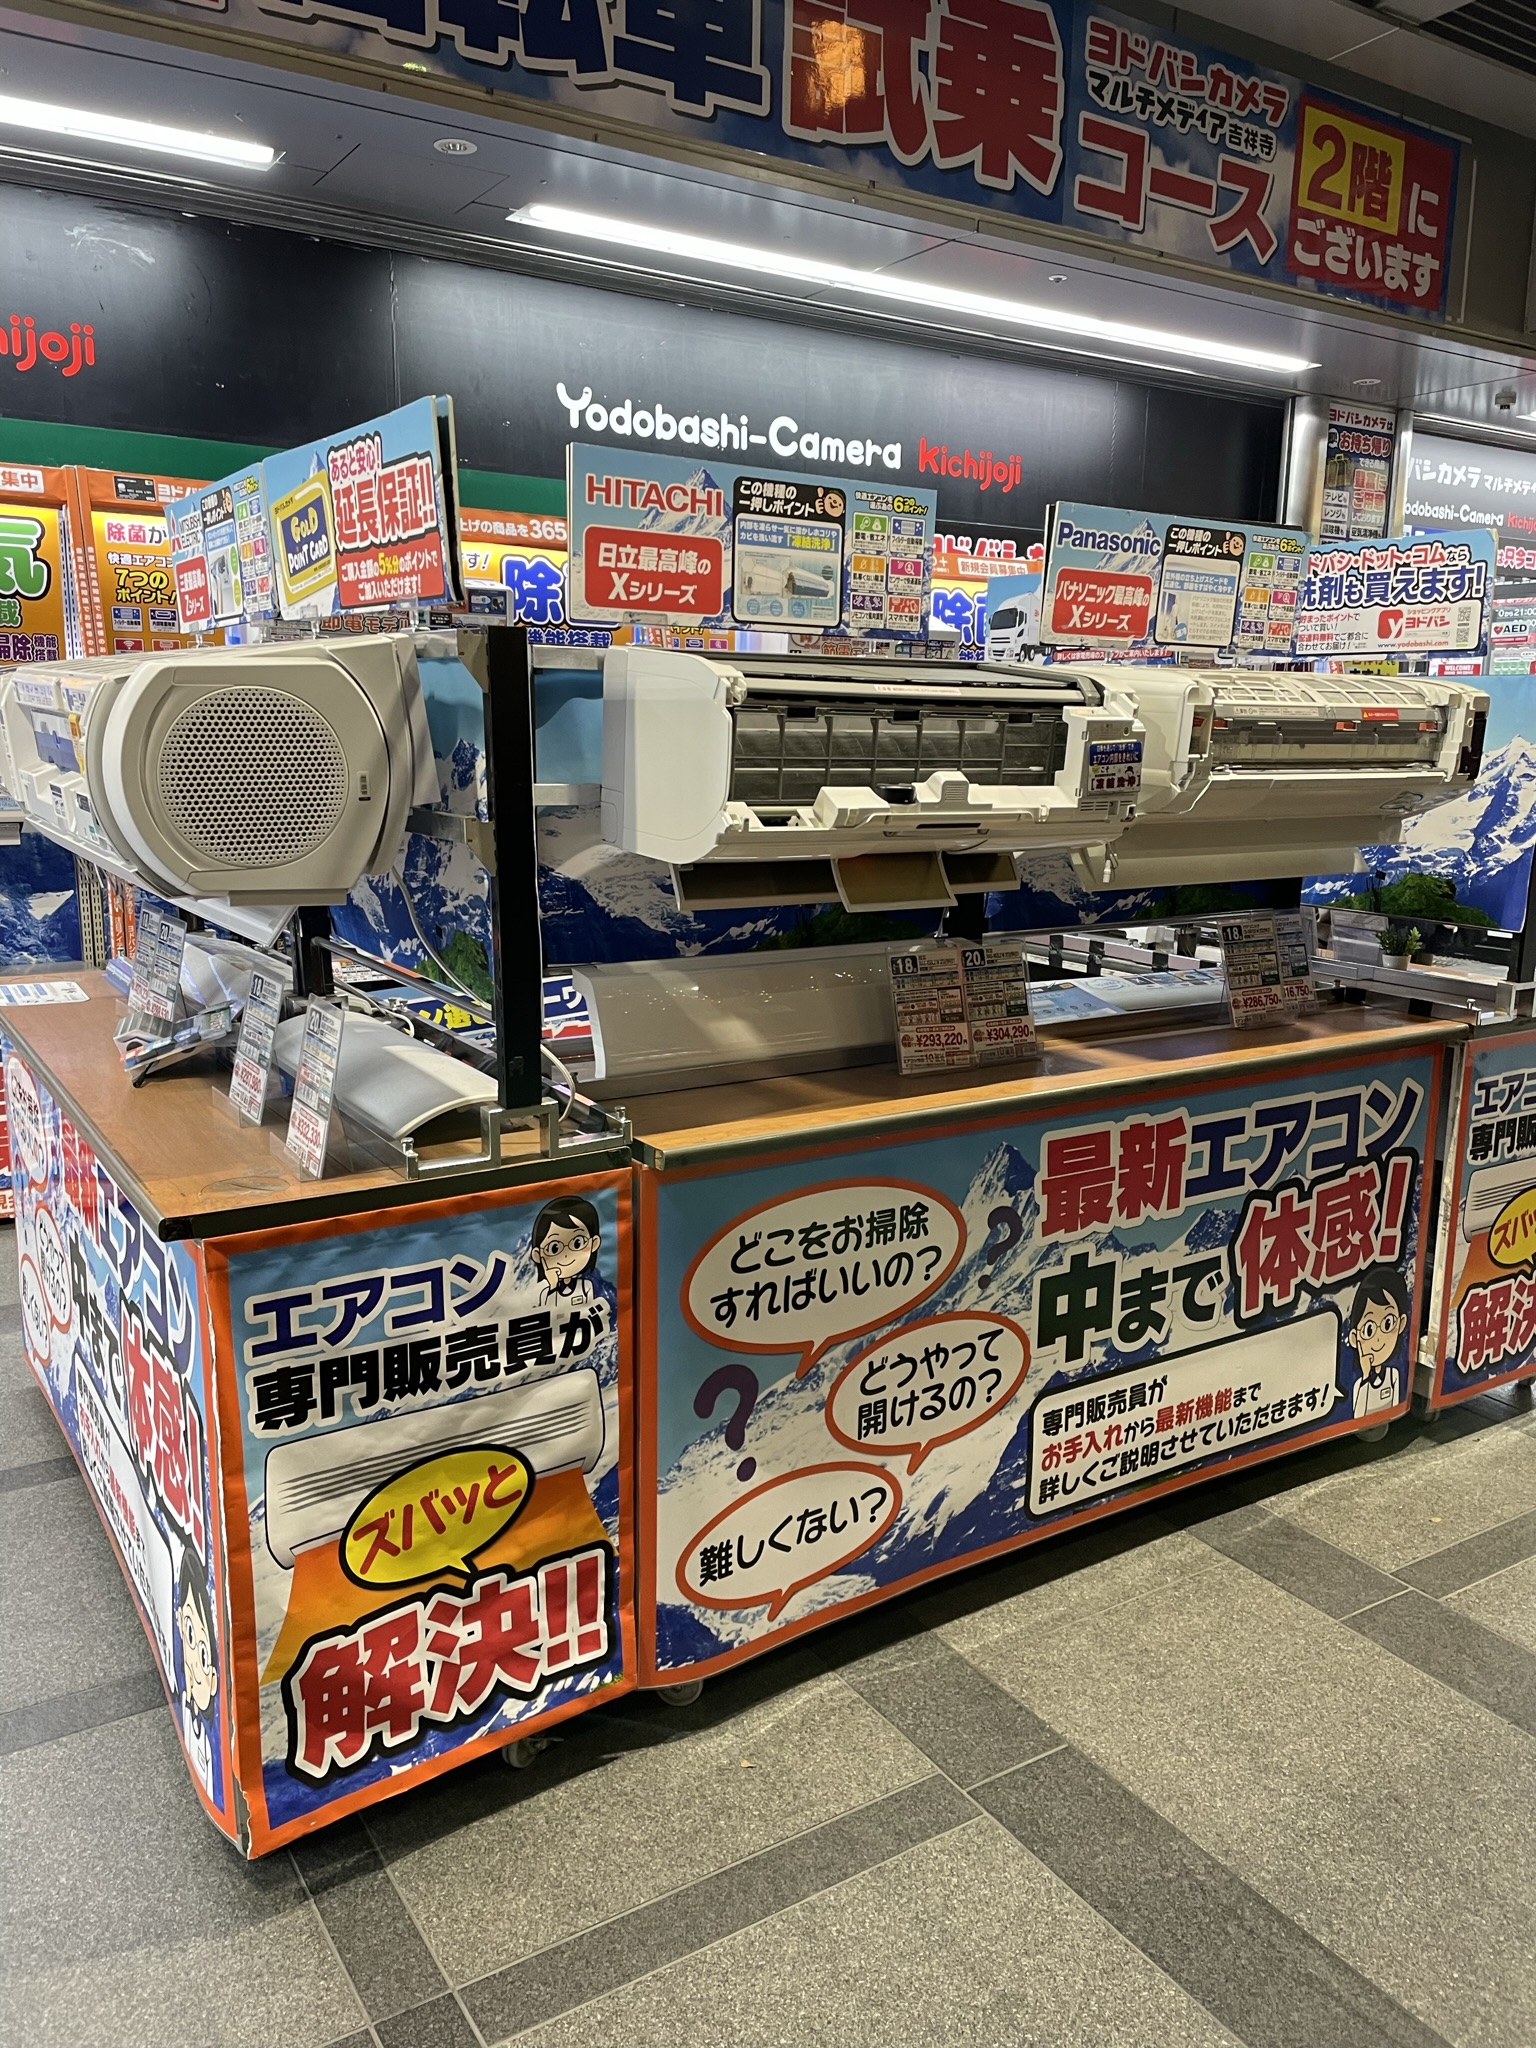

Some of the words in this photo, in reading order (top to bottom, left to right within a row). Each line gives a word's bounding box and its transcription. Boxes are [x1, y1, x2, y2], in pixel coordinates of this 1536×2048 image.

[1087, 20, 1289, 123] ヨドバシカメラ
[1086, 70, 1276, 159] マルチメディア吉祥寺
[1078, 114, 1279, 266] コース
[1309, 129, 1440, 239] 2階に
[1294, 217, 1441, 298] ございます
[556, 382, 902, 469] Yodobashi-Camera
[918, 438, 1022, 492] Kichijoji
[1329, 408, 1393, 431] ヨドバシカメラは
[1339, 432, 1392, 458] お持ち帰り
[587, 474, 723, 517] HITACHI
[738, 496, 815, 518] 一押しポイント
[739, 480, 797, 500] この機種の
[598, 542, 712, 576] 日立最高峰の
[1057, 521, 1162, 557] Panasonic
[1168, 539, 1223, 557] 一押しポイント
[1170, 527, 1212, 542] この機種の
[115, 569, 169, 590] 7つの
[117, 587, 177, 604] ポイント!
[608, 571, 698, 606] Xシリーズ
[1056, 580, 1150, 608] パナソニック最高峰の
[1068, 604, 1132, 631] Xシリーズ
[1377, 639, 1449, 649] www.yodobashi.com
[1405, 615, 1451, 629] ヨドバシ
[1503, 625, 1528, 633] AED
[1041, 1084, 1421, 1238] 最新エアコン
[729, 1201, 931, 1275] どこをお掃除
[252, 1258, 504, 1359] エアコン
[709, 1245, 943, 1328] すればいいの?
[253, 1303, 603, 1433] 専門販売員が
[858, 1328, 1005, 1397] どうやって
[856, 1367, 1004, 1441] 開けるの?
[1041, 1382, 1262, 1473] お手入れから最新機能まで
[1042, 1375, 1168, 1437] 専門販売員が
[1039, 1383, 1331, 1506] 詳しくご説明させていただきます!
[350, 1463, 524, 1576] ズバッと
[699, 1486, 888, 1587] 難しくない?
[300, 1548, 602, 1773] 解決!!
